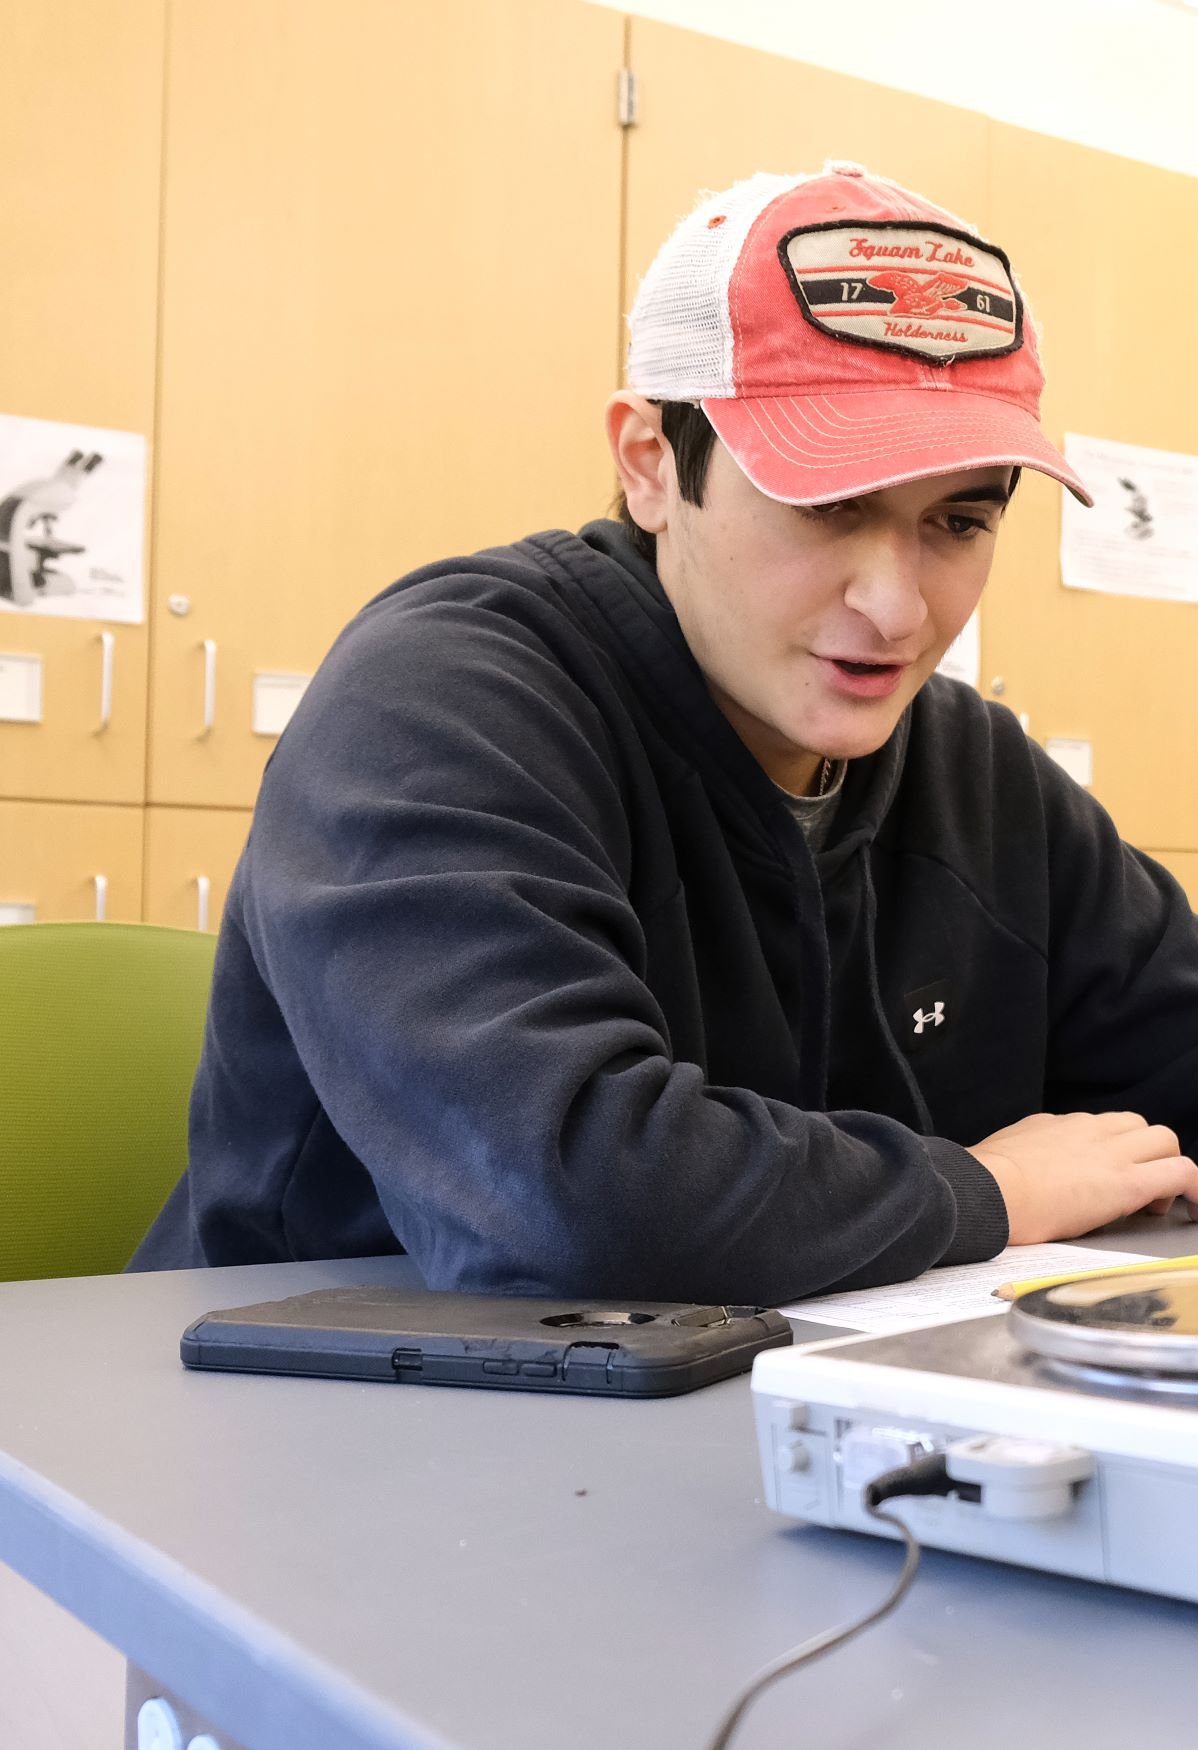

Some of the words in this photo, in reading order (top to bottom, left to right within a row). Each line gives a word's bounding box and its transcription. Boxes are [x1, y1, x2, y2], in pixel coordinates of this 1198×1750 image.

[849, 238, 923, 261] Squam
[925, 241, 974, 268] Lake
[841, 282, 863, 302] 17
[976, 294, 991, 313] 61
[884, 321, 968, 344] Holderness
